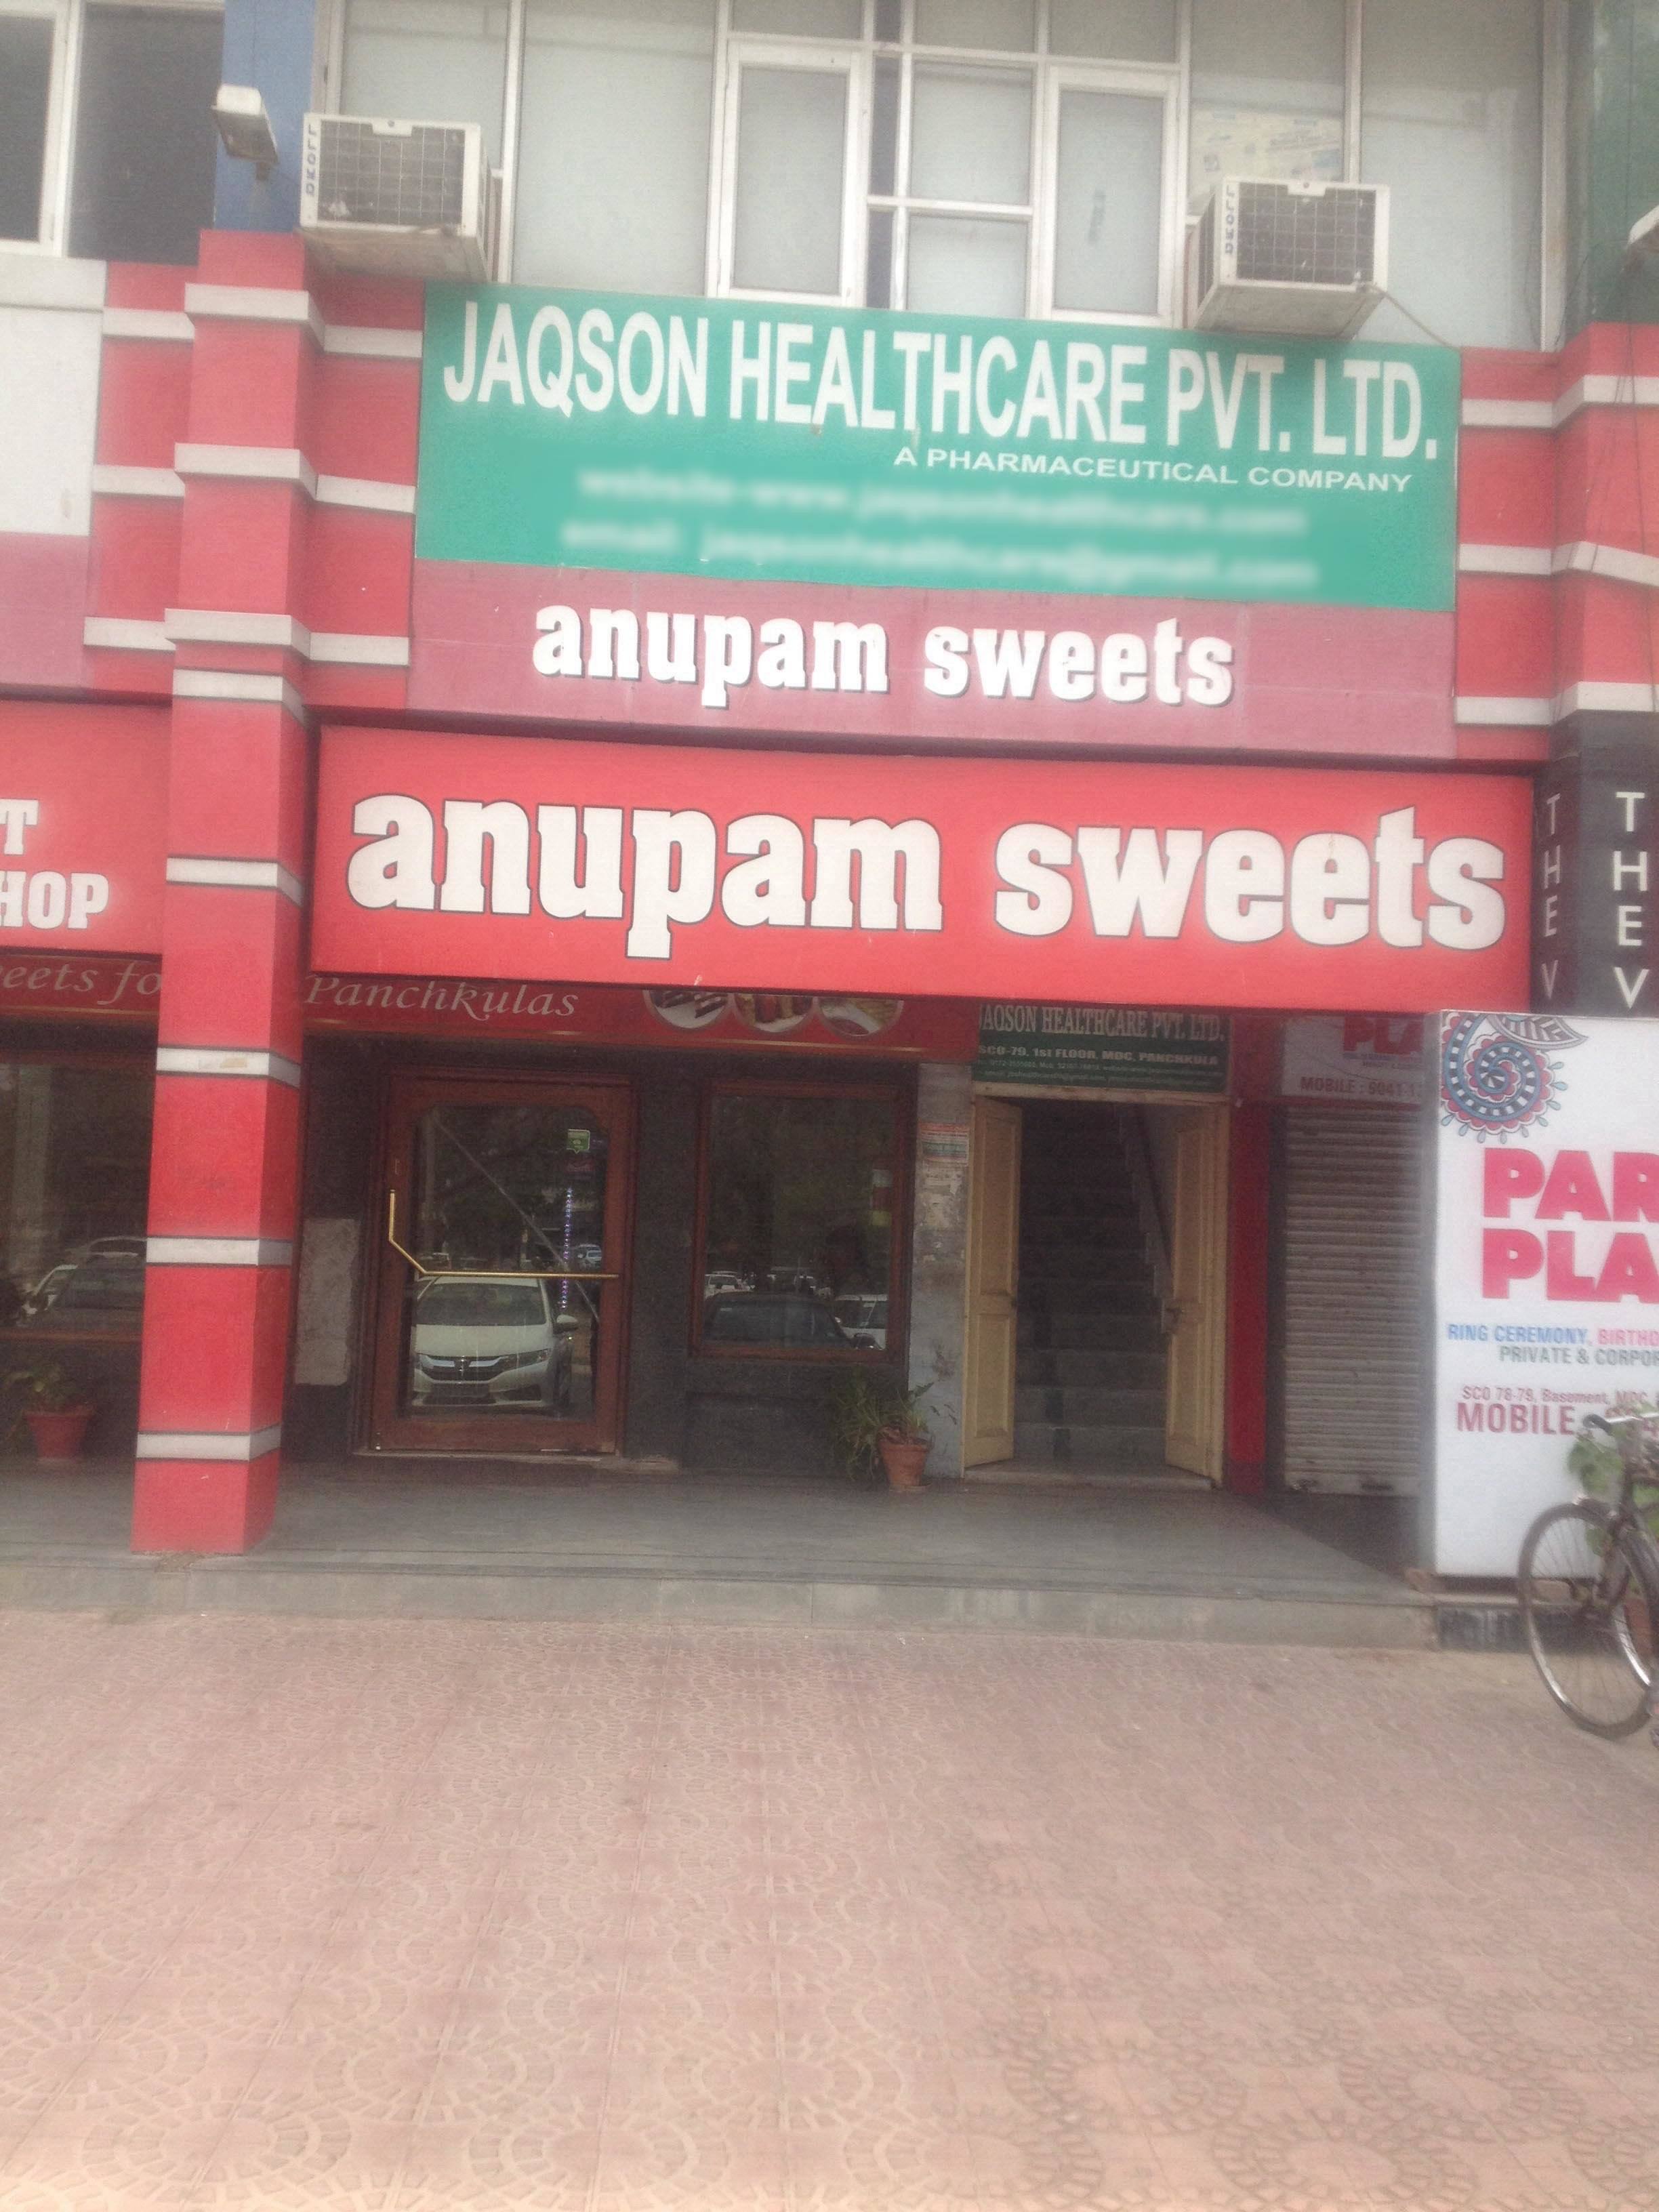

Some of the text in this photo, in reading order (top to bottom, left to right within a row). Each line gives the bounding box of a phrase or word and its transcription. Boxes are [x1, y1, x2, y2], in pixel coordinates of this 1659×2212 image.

[443, 301, 1437, 459] JAQSON HEALTHCARE PVT. LTD.
[895, 447, 1412, 492] A PHARMACEUTICAL COMPANY
[533, 605, 1234, 708] anupam sweets
[347, 794, 1506, 958] anupam sweets
[0, 964, 98, 993] eets
[304, 973, 578, 1021] Panchkulas
[1042, 1006, 1148, 1038] HEALTHCARE
[1448, 1324, 1488, 1341] RING
[1498, 1346, 1572, 1364] PRIVATE
[1577, 1349, 1589, 1366] &
[1462, 1386, 1491, 1401] SCO
[1457, 1402, 1575, 1435] MOBILE
